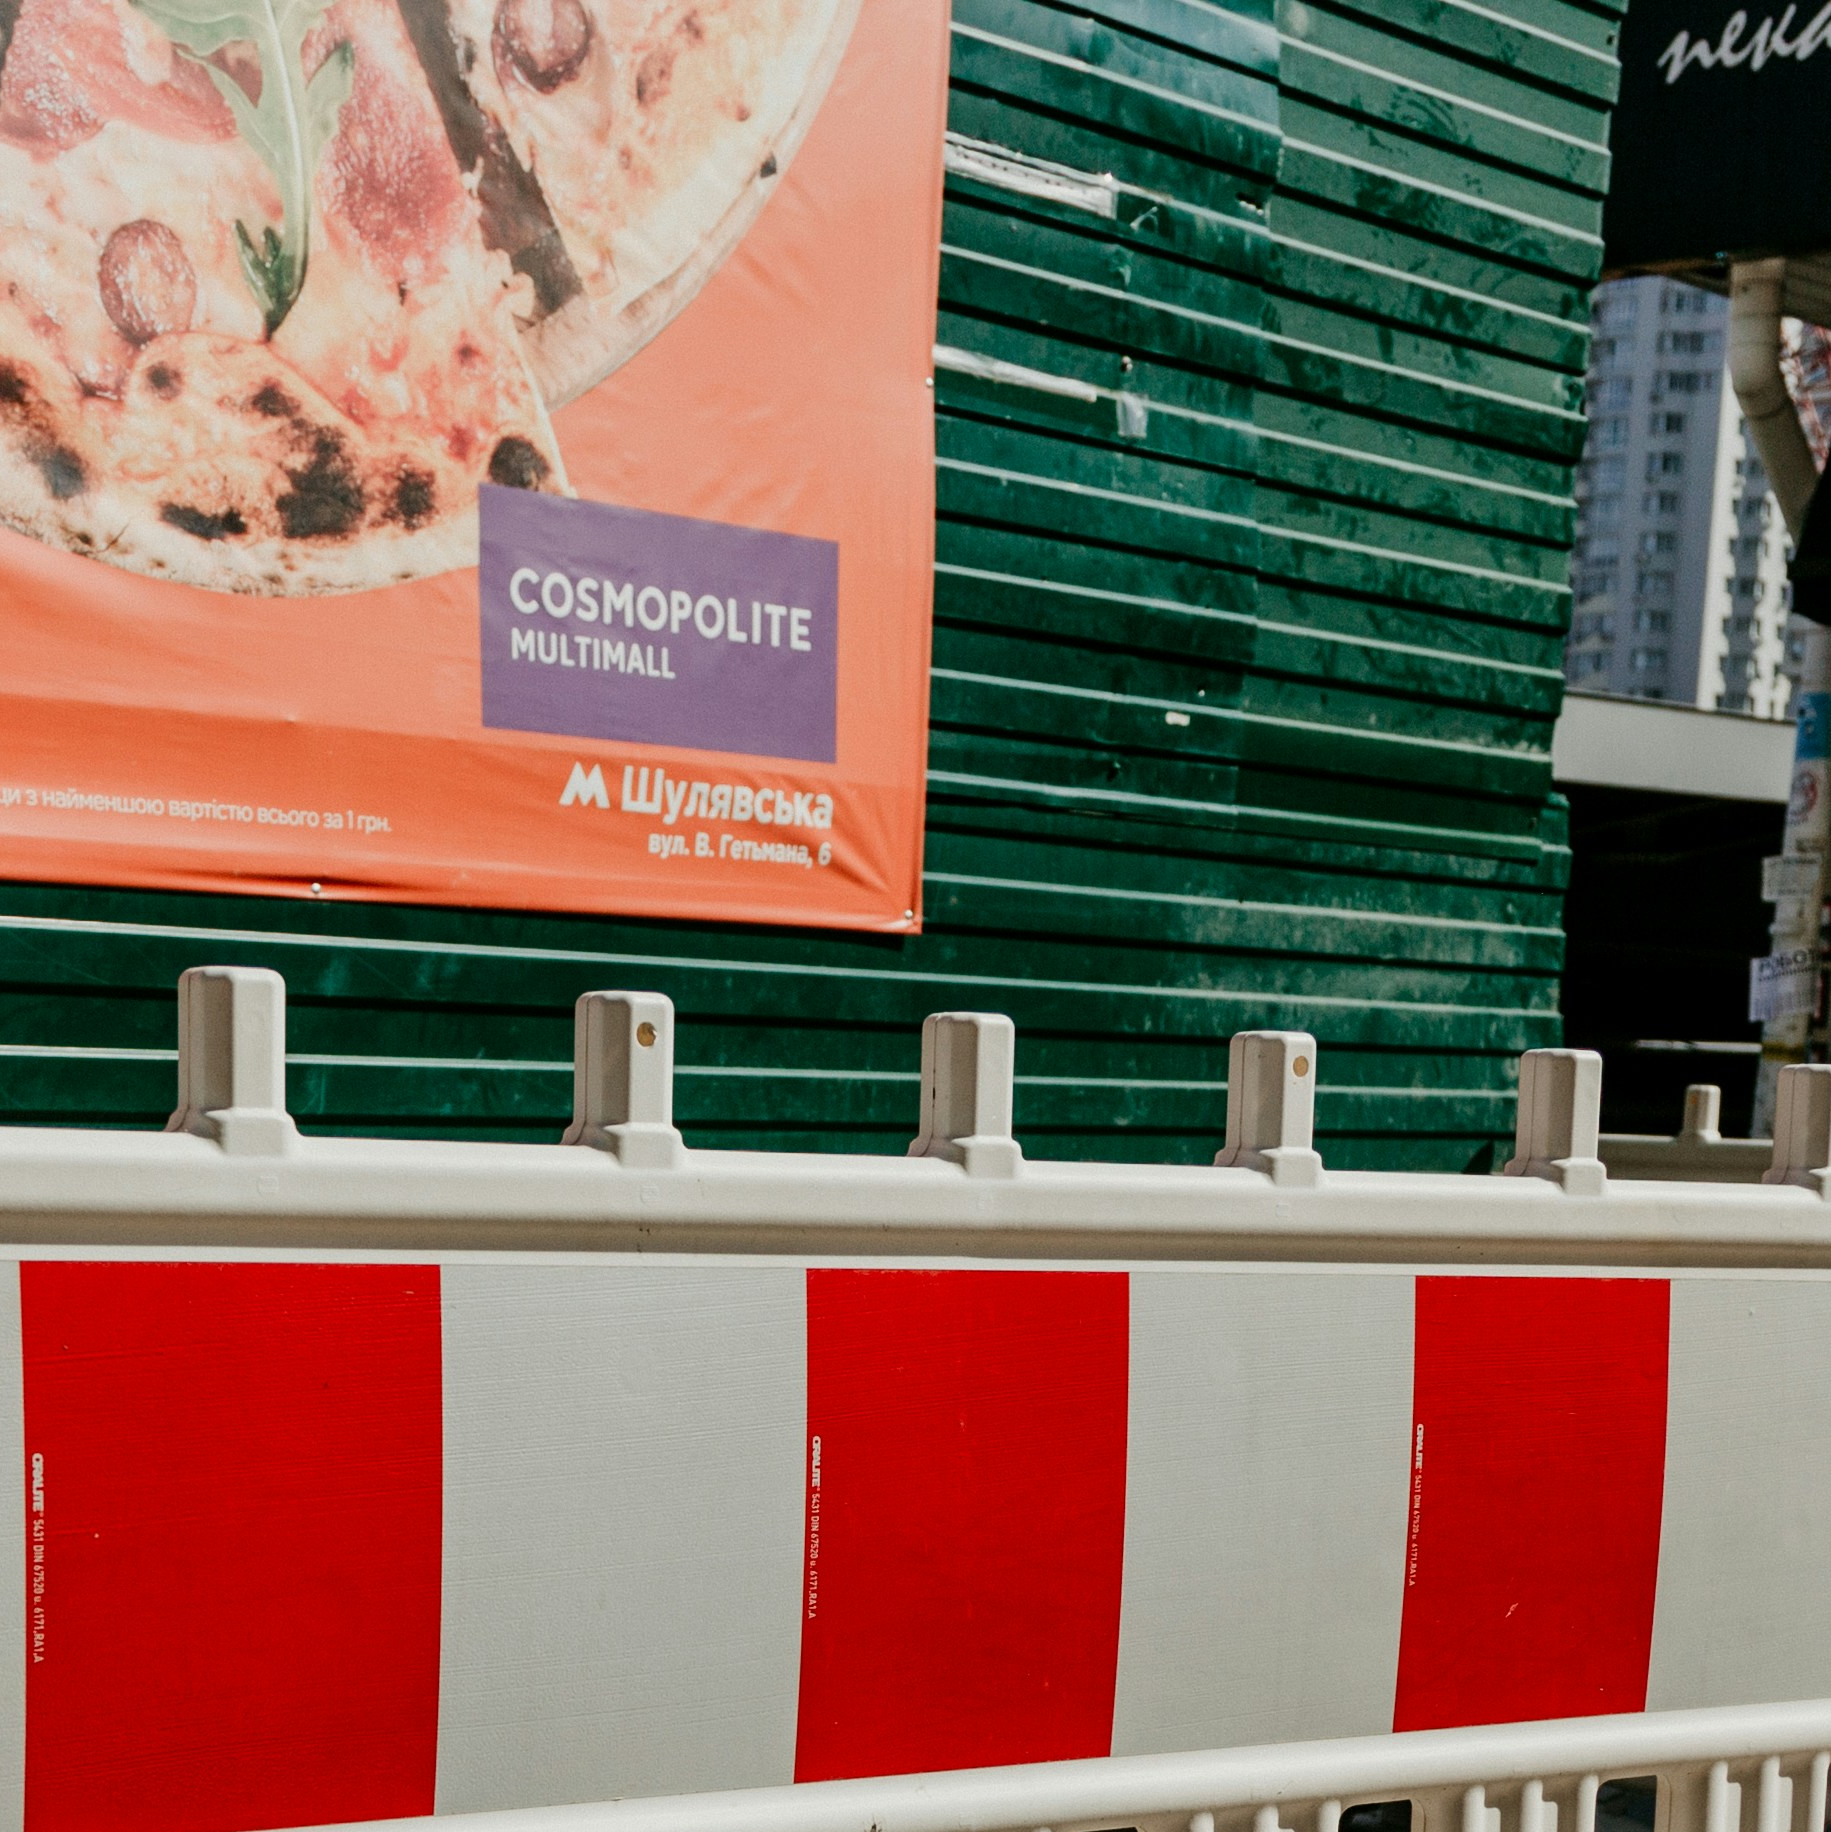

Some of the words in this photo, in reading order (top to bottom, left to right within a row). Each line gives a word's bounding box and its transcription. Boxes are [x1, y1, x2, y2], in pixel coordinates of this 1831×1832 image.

[509, 567, 812, 652] COSMOPOLITE
[511, 627, 676, 679] MULTIMALL
[26, 788, 38, 807] з
[42, 788, 165, 816] найменшою
[169, 800, 253, 825] вартістю
[257, 808, 319, 828] всього
[323, 813, 343, 830] за
[357, 816, 392, 834] грн.
[621, 765, 833, 829] Шулявська
[648, 833, 689, 859] вул.
[695, 832, 715, 857] В.
[719, 834, 813, 867] Гетьмана,
[817, 841, 832, 866] 6
[811, 1493, 821, 1513] 5431
[33, 1519, 45, 1541] 5431
[810, 1516, 820, 1531] DIN
[33, 1545, 45, 1562] DIN
[809, 1533, 819, 1560] 67520
[33, 1565, 45, 1594] 67520
